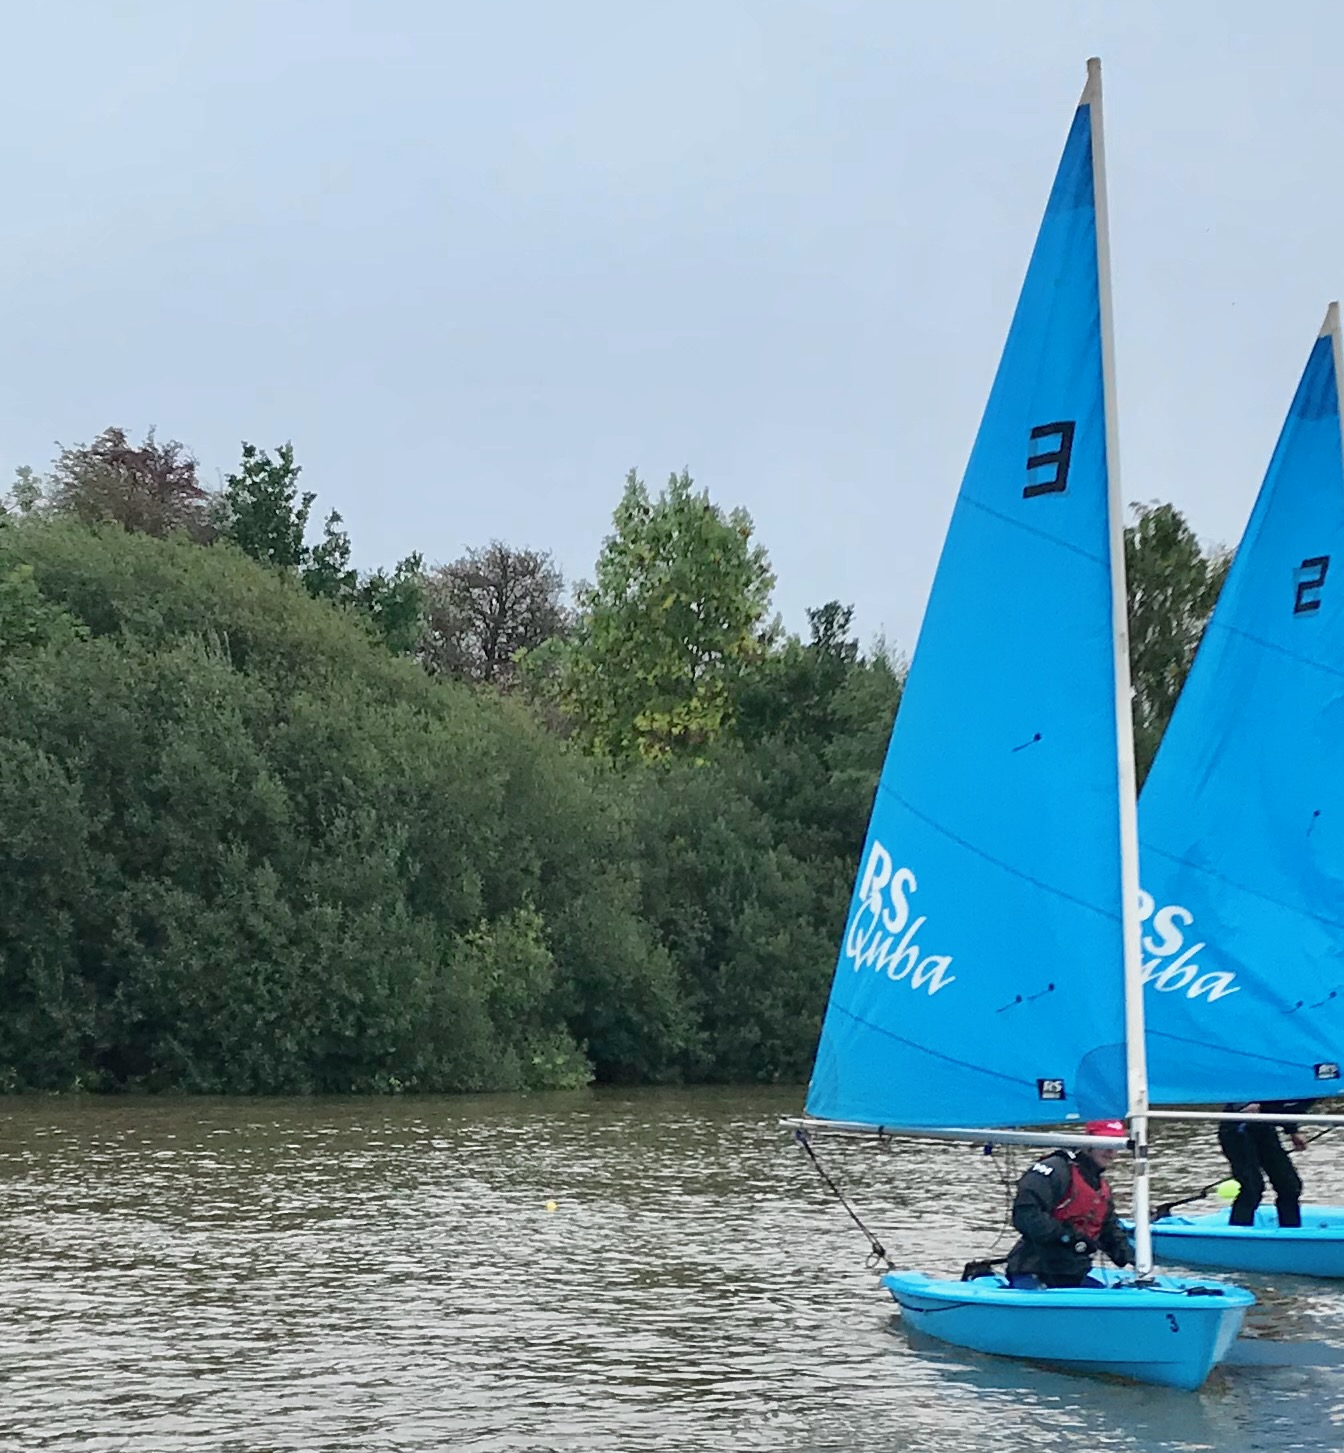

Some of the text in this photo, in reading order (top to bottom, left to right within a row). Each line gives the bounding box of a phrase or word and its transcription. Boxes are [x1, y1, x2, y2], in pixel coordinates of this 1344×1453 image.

[1022, 421, 1076, 499] 3
[1293, 555, 1330, 614] 2
[859, 840, 918, 934] RS
[846, 900, 956, 996] Quba
[1166, 1313, 1180, 1333] 3
